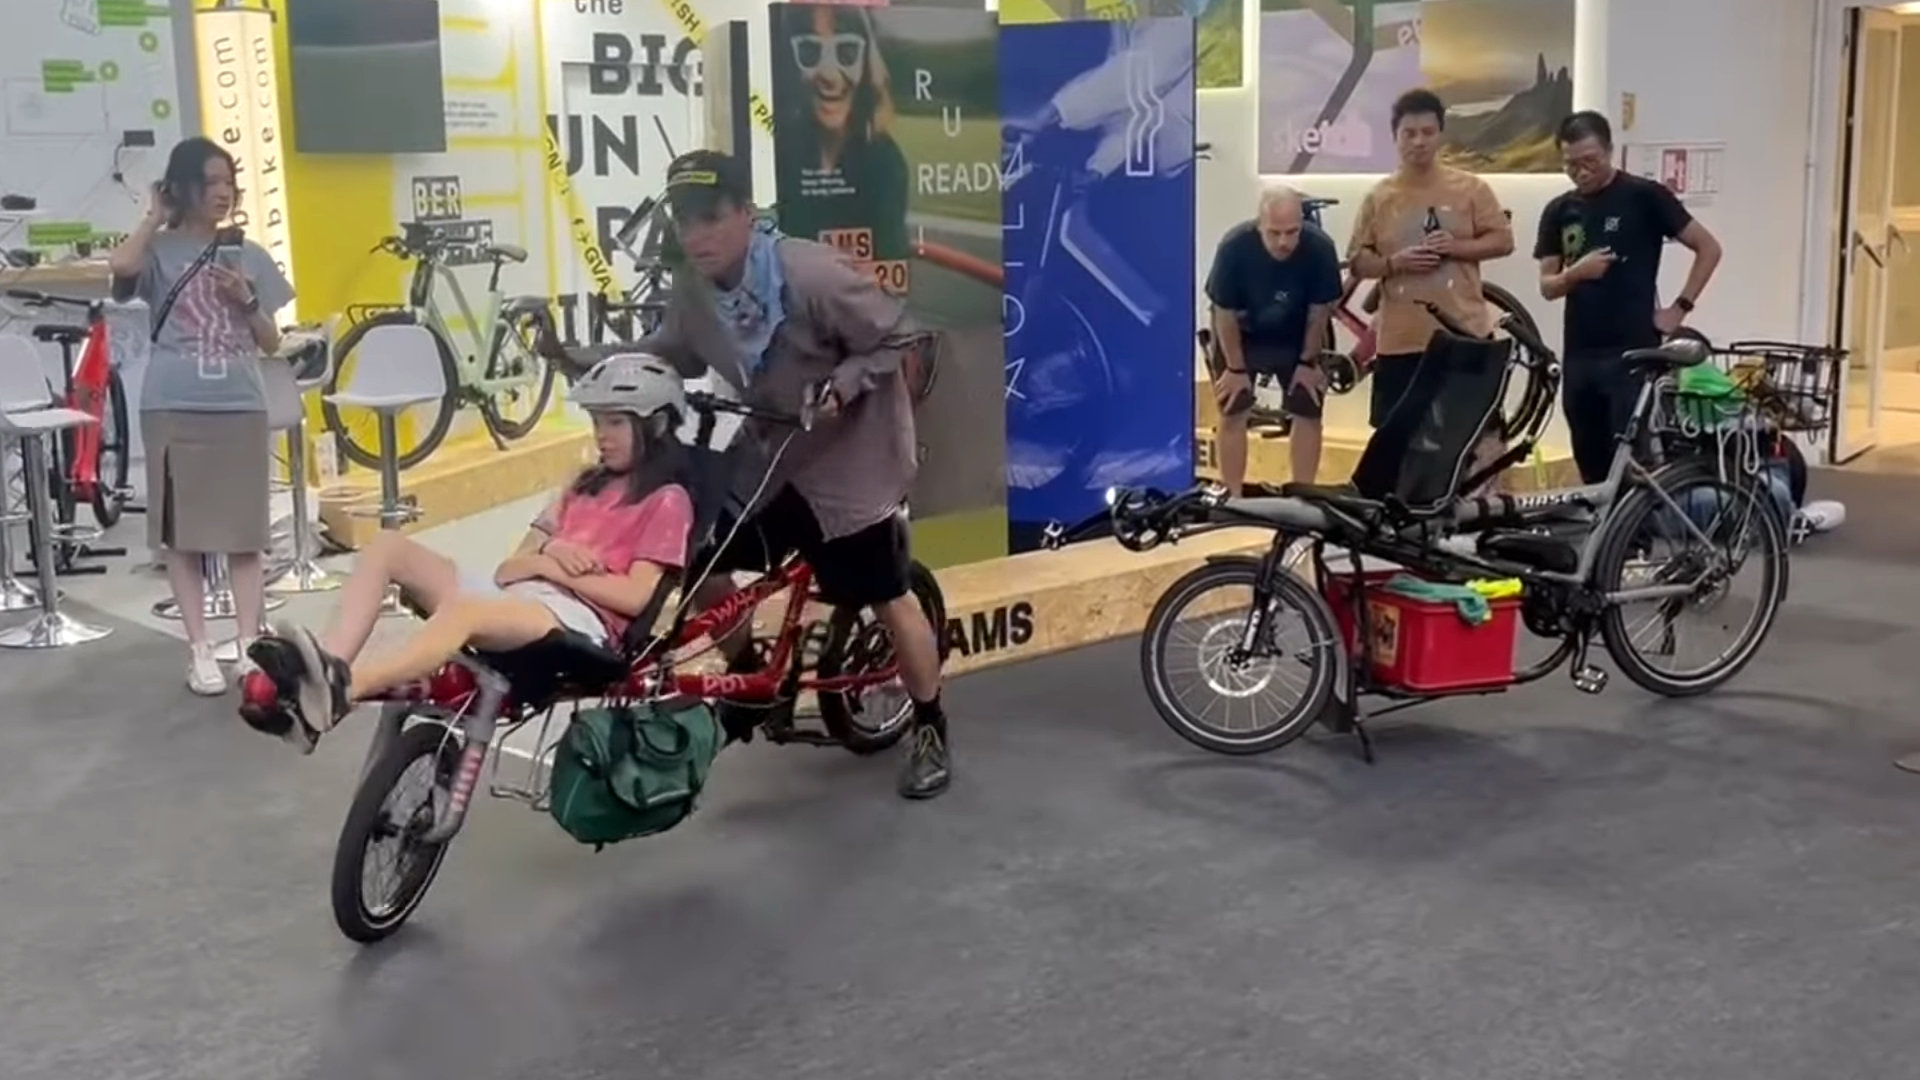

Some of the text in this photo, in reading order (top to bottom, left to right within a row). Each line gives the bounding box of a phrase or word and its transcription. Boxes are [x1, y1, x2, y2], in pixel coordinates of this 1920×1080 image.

[915, 69, 932, 100] R
[942, 106, 961, 138] U
[917, 162, 1010, 194] READY
[414, 181, 461, 217] BER
